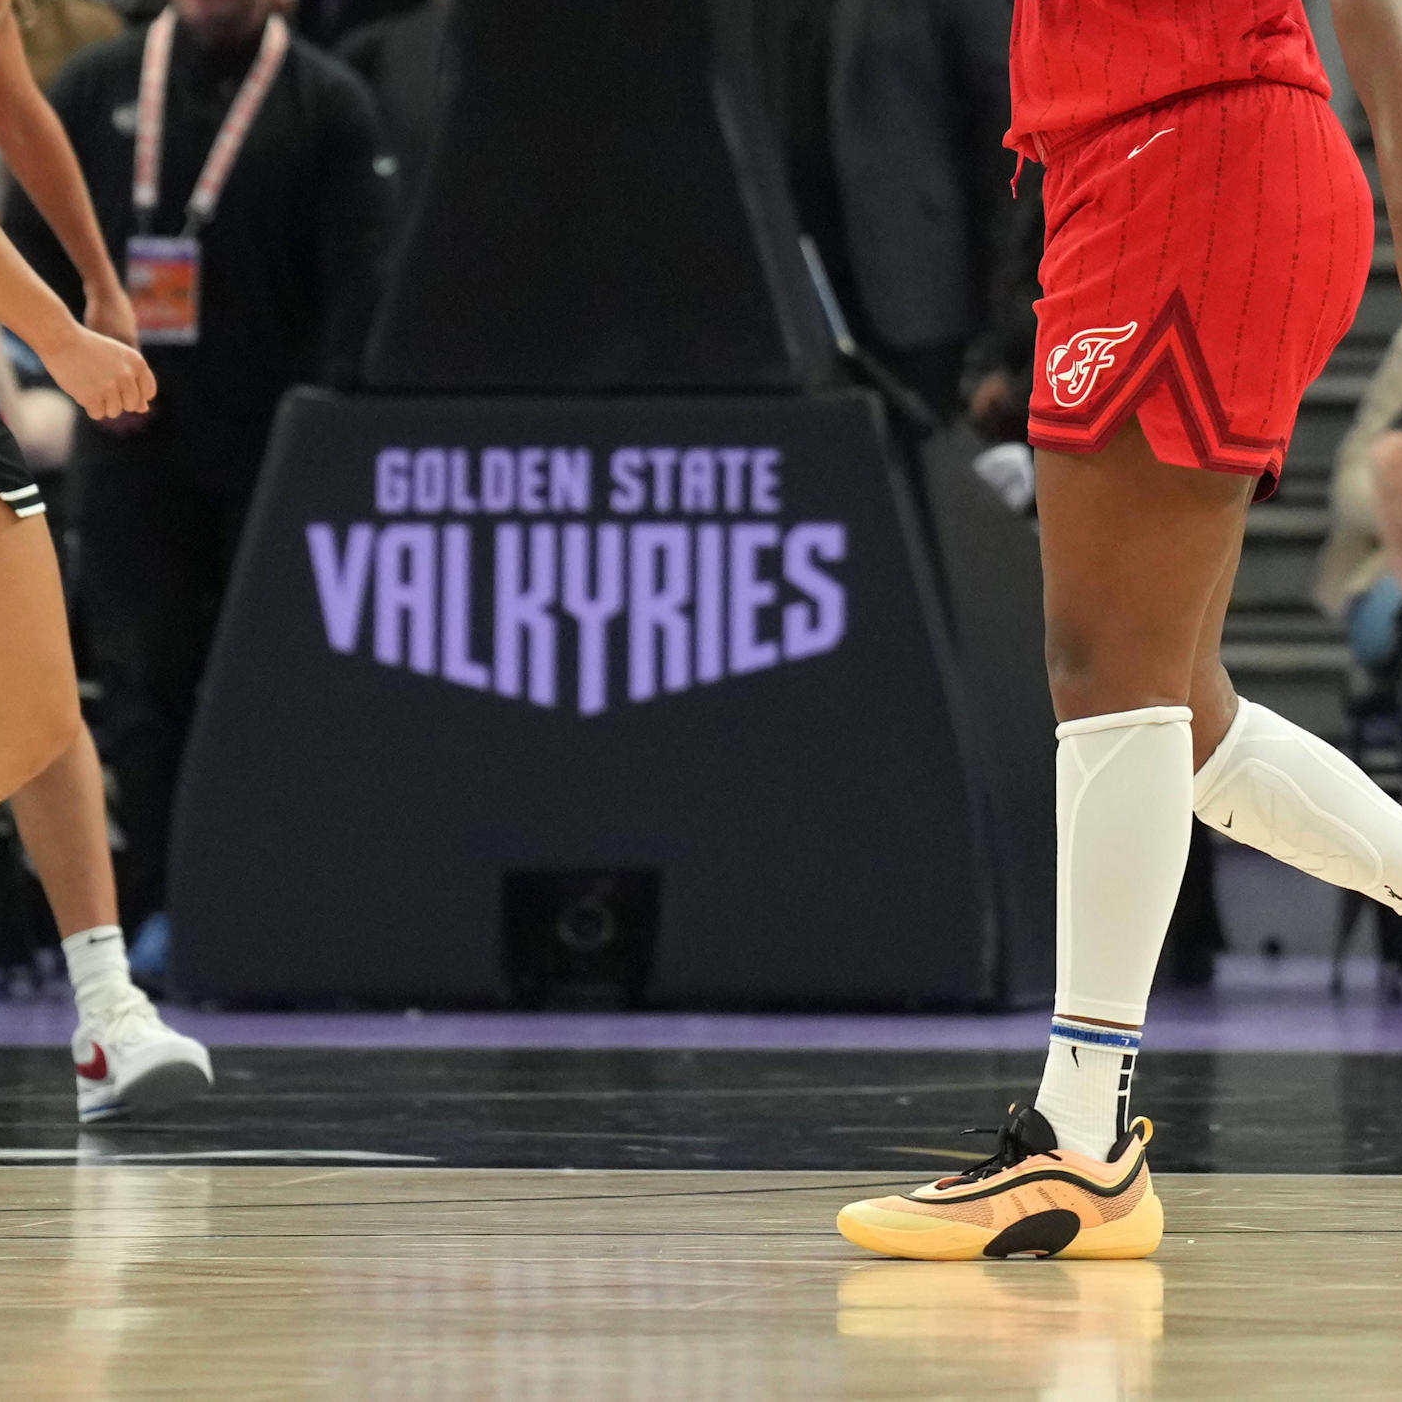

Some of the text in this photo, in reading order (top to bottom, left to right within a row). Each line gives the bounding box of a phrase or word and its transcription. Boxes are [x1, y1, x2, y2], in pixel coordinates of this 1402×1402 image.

[375, 447, 781, 514] GOLDEN STATE
[305, 522, 847, 716] VALKYRIES
